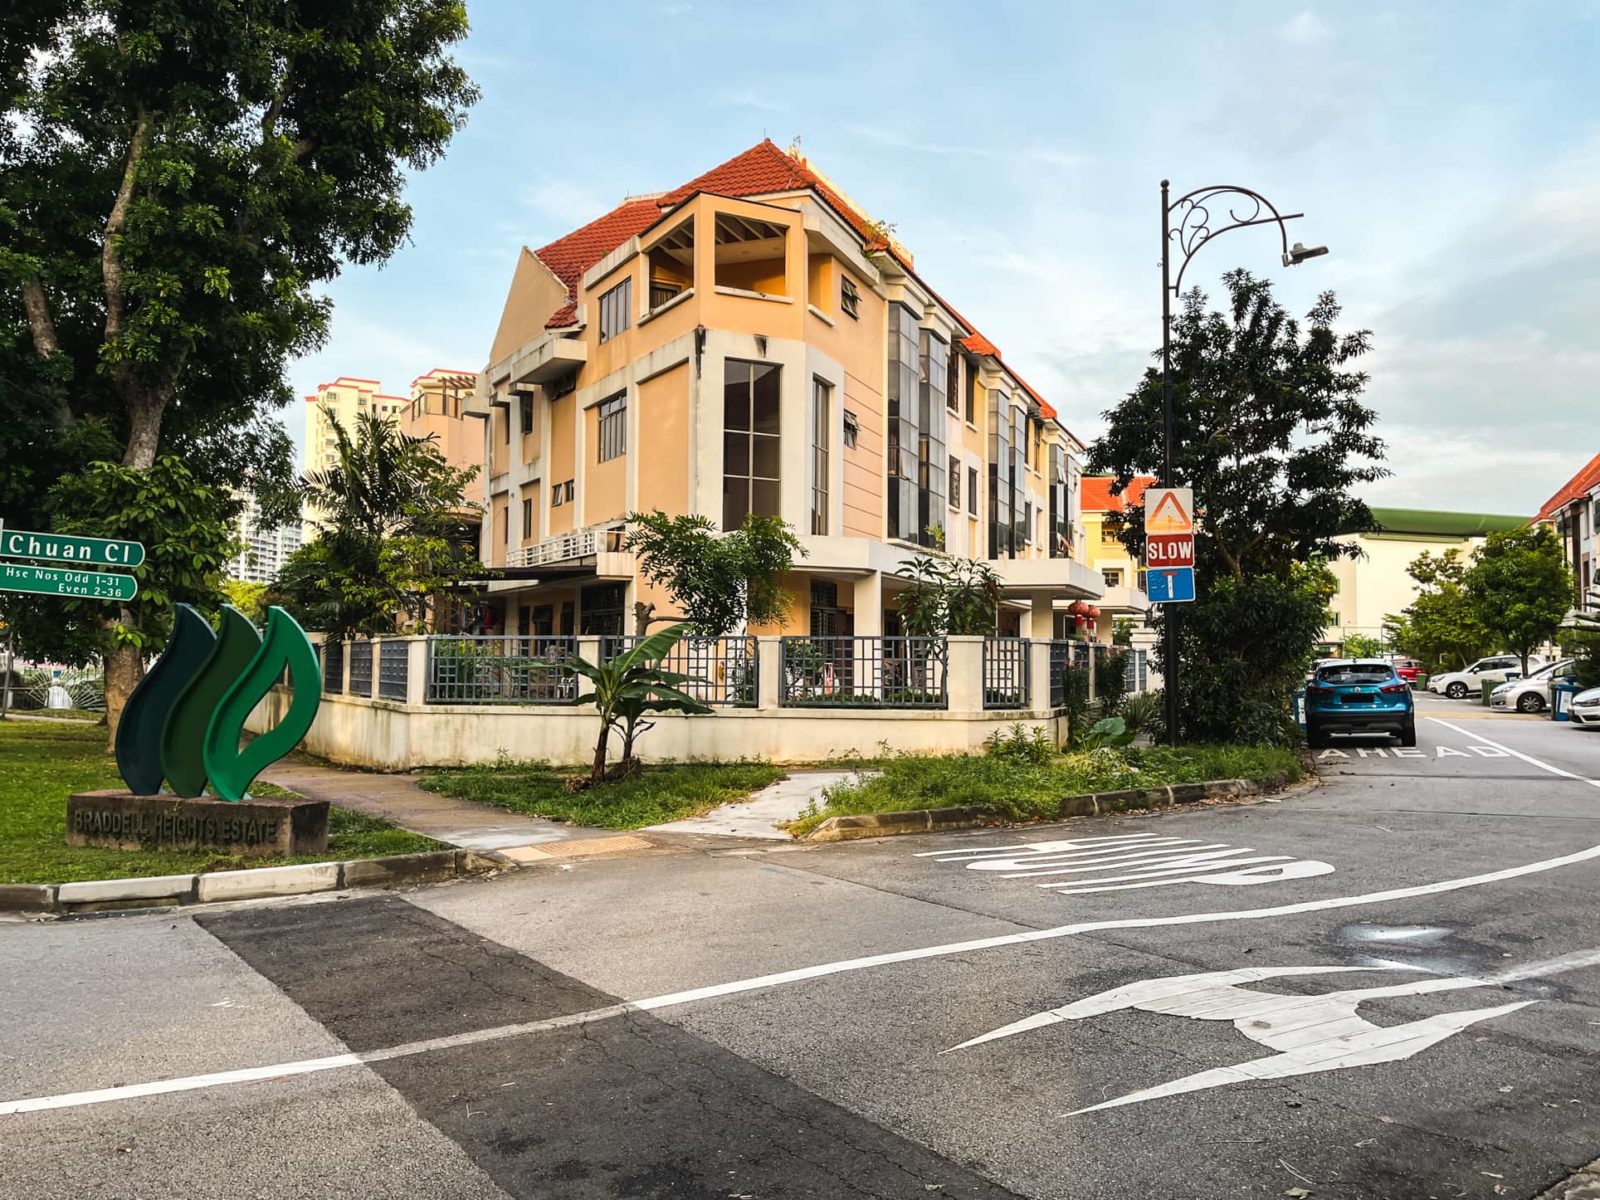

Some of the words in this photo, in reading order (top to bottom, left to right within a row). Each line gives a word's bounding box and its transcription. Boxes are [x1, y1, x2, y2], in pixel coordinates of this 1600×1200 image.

[9, 535, 91, 559] Chuan
[105, 543, 129, 562] Cl
[1148, 541, 1192, 560] SLOW
[6, 567, 29, 578] Hse
[35, 570, 58, 581] Nos
[64, 573, 89, 584] Odd
[95, 575, 119, 586] 1-31
[58, 583, 88, 594] Even
[94, 587, 122, 597] 2-36
[1318, 745, 1510, 759] AHEAD
[74, 809, 147, 834] BRADDELL
[153, 814, 216, 840] HEIGHTS
[221, 818, 277, 843] ESTATE
